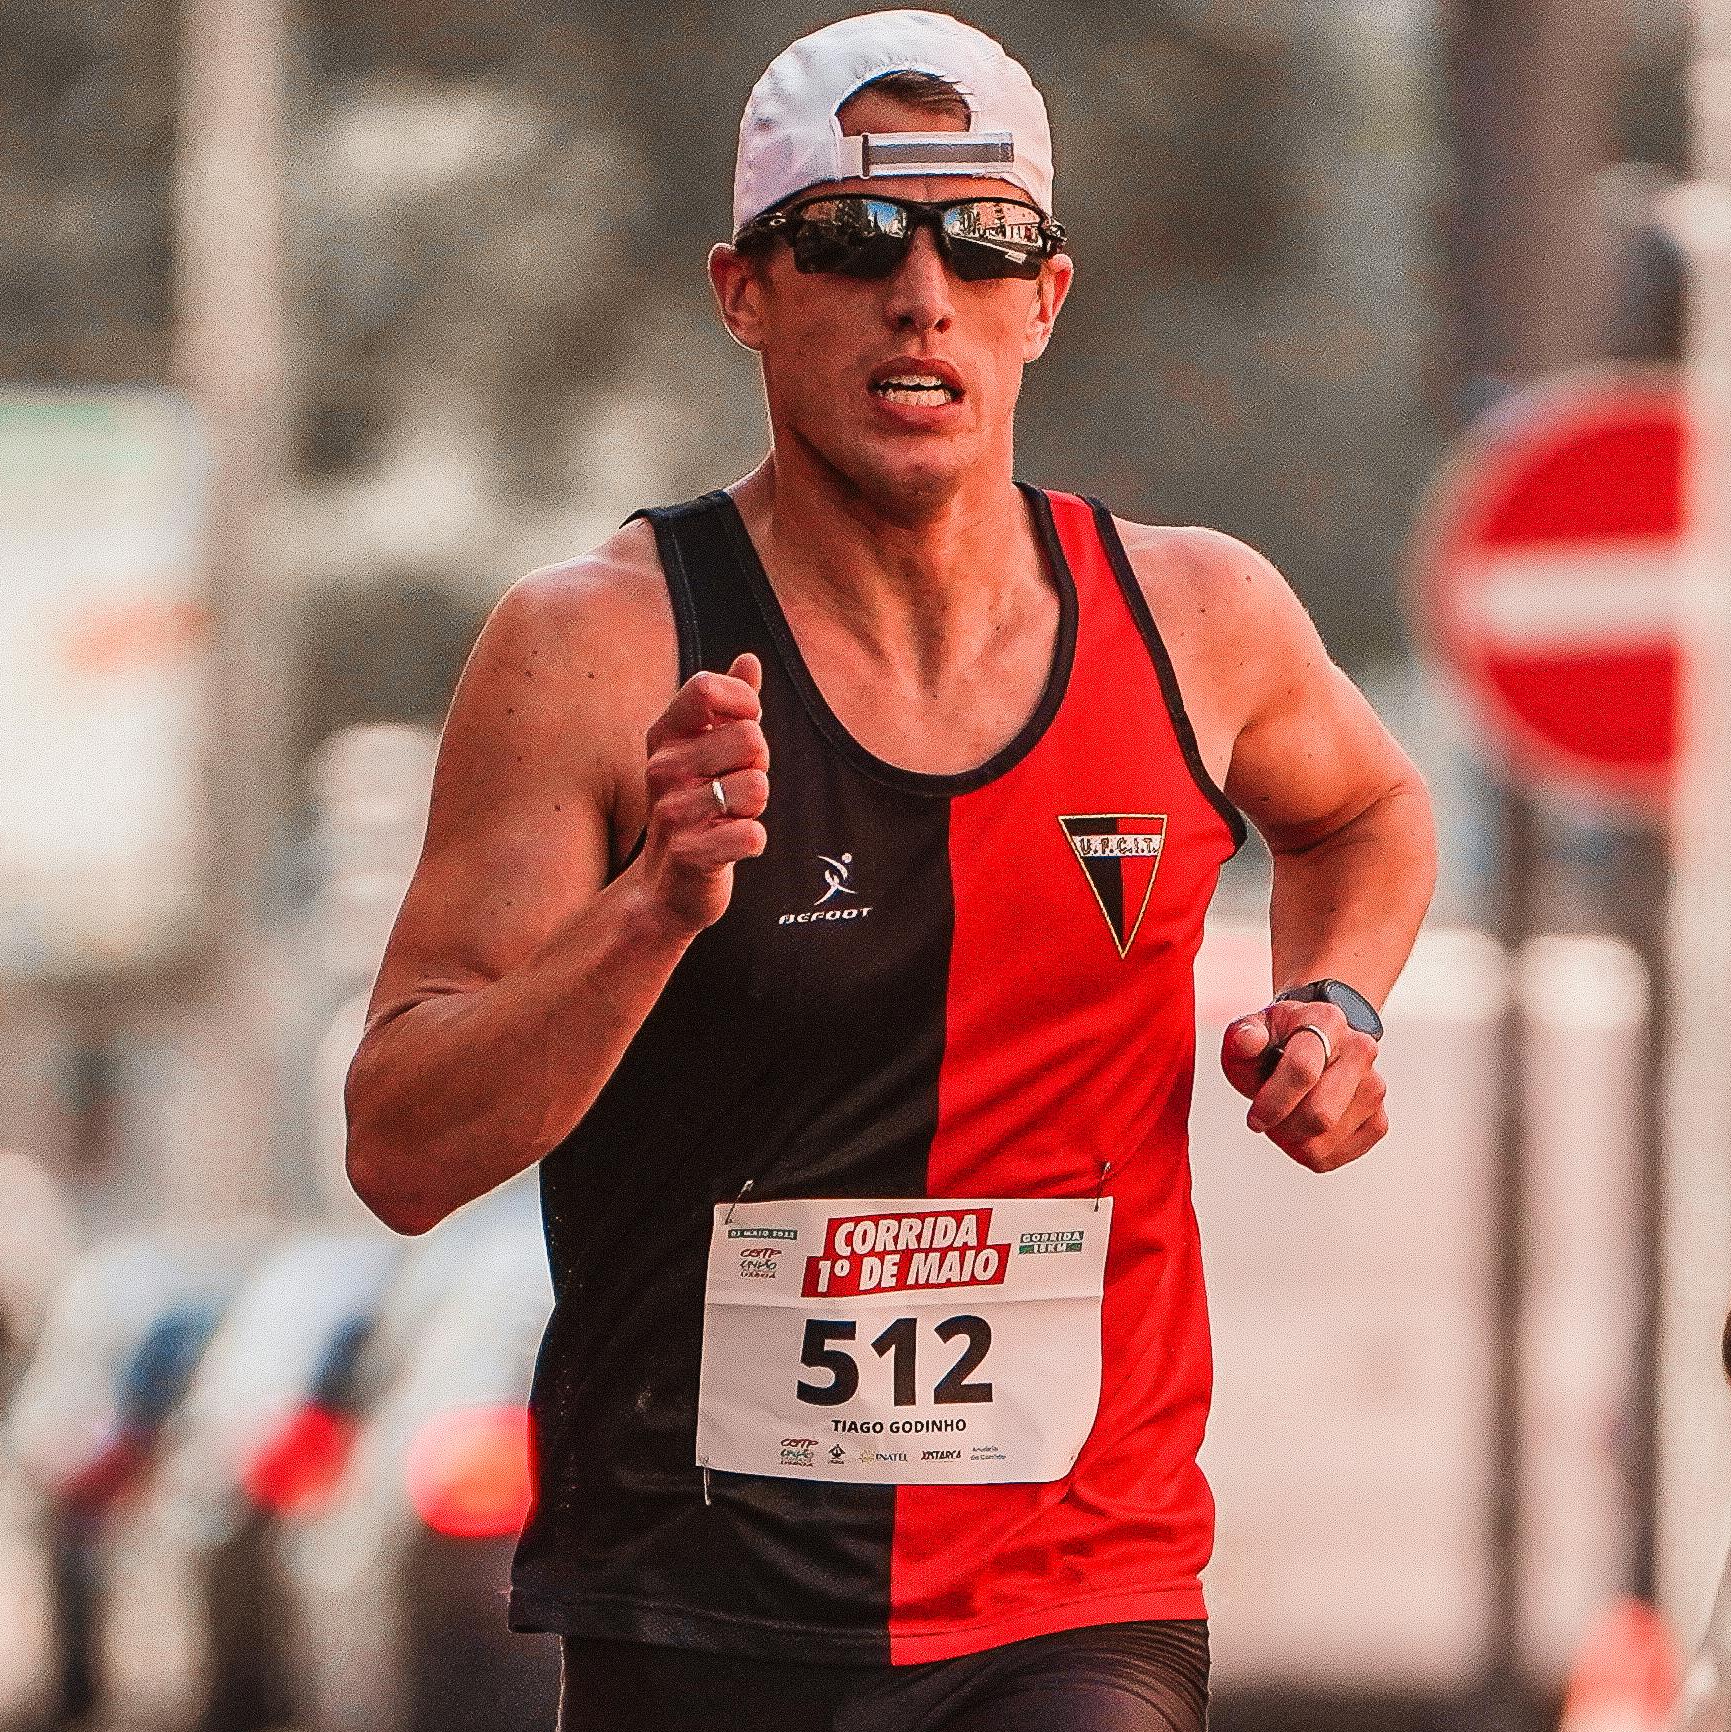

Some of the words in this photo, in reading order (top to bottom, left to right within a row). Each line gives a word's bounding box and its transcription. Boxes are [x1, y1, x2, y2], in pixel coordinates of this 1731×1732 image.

[834, 1214, 978, 1257] CORRIDA
[1022, 1231, 1081, 1242] CORRIDA
[859, 1253, 901, 1291] DE
[906, 1248, 999, 1285] MAIO
[796, 1314, 994, 1407] 512
[831, 1419, 884, 1434] TIAGO
[889, 1418, 967, 1434] GODINHO
